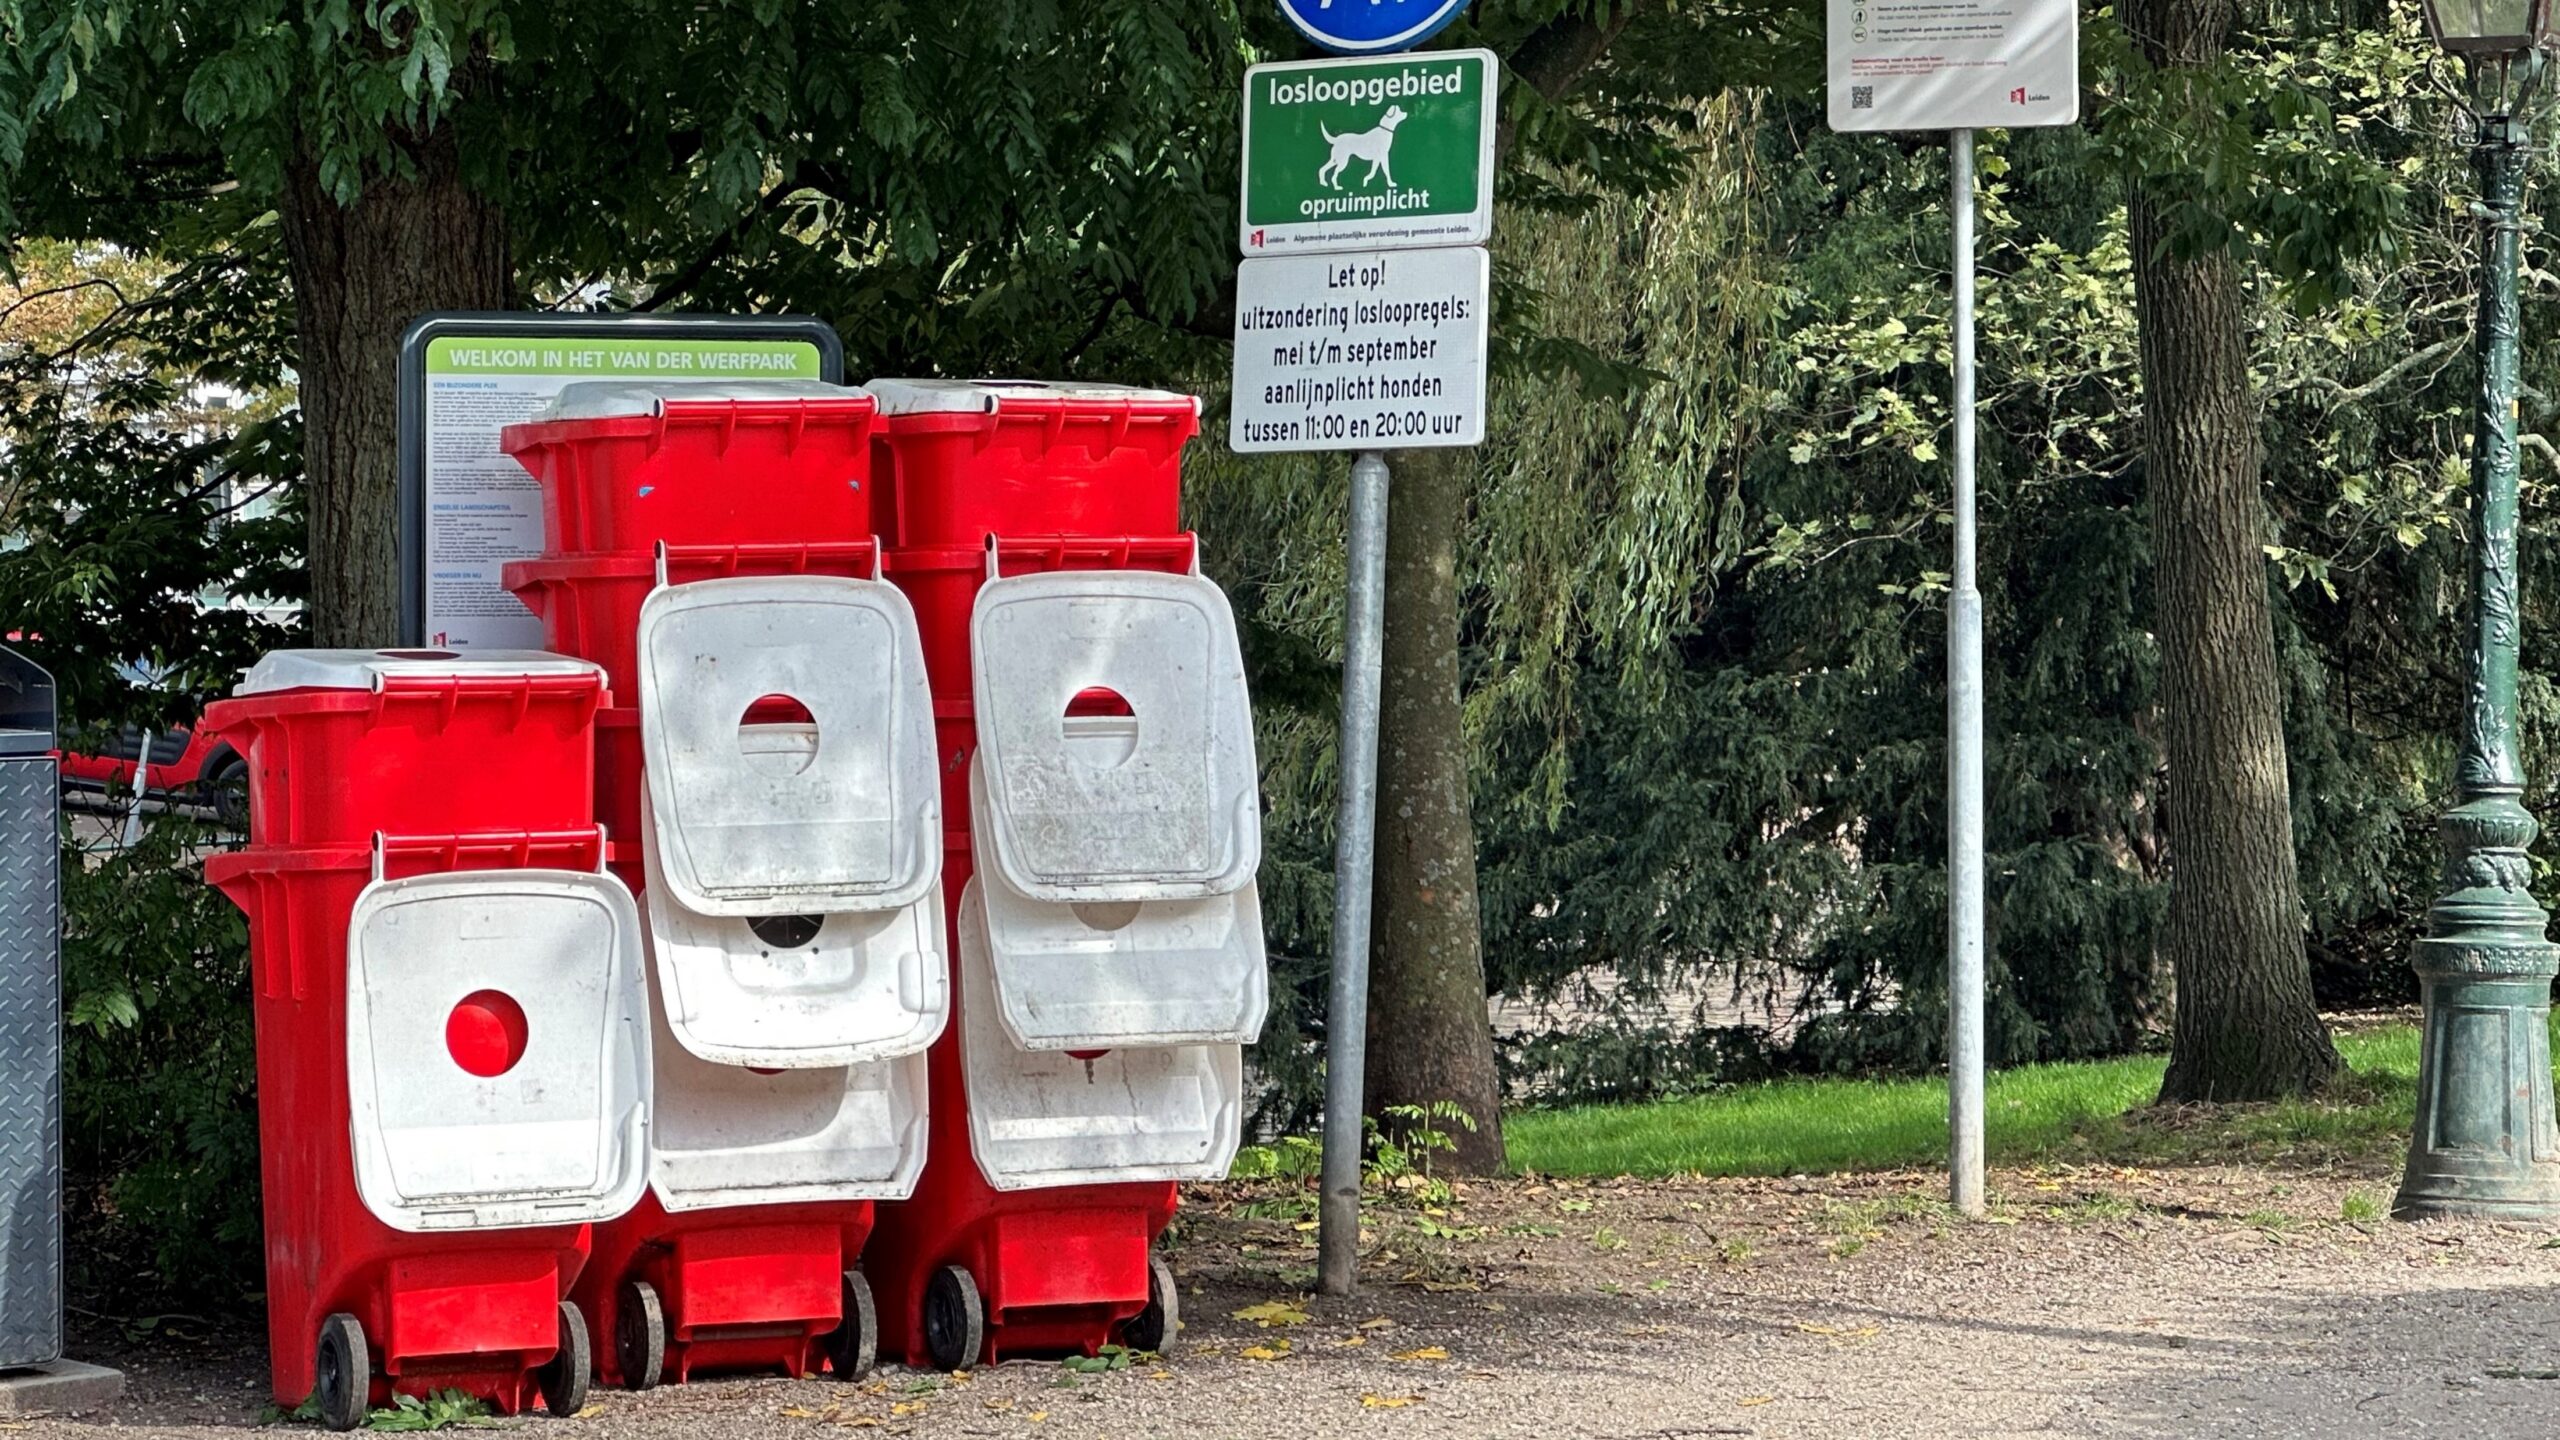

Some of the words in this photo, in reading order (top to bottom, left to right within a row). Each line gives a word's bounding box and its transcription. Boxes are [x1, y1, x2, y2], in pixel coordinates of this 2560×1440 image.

[1270, 66, 1462, 106] losloopgebied
[2029, 94, 2050, 102] Leiden
[1300, 188, 1429, 218] opruimplicht
[1294, 234, 1326, 243] Algemene
[1328, 231, 1367, 241] plaatselijke
[1369, 229, 1409, 238] verordening
[1411, 228, 1445, 237] gemeente
[1447, 225, 1471, 234] Leiden.
[1329, 262, 1355, 288] Let
[1361, 259, 1386, 291] op!
[1242, 302, 1348, 333] uitzondering
[1355, 295, 1470, 328] losloopregels:
[450, 349, 536, 367] WELKOM
[543, 351, 562, 368] IN
[569, 351, 605, 368] HET
[610, 351, 650, 369] VAN
[656, 352, 692, 369] DER
[698, 352, 797, 370] WERFPARK
[1274, 341, 1303, 366] mei
[1309, 337, 1341, 366] t/m
[1347, 335, 1437, 367] september
[1264, 375, 1375, 410] aanlijnplicht
[1380, 372, 1442, 399] honden
[1244, 418, 1299, 442] tussen
[1305, 414, 1345, 440] 11:00
[1350, 418, 1369, 438] en
[1375, 411, 1426, 437] 20:00
[1432, 414, 1462, 435] uur
